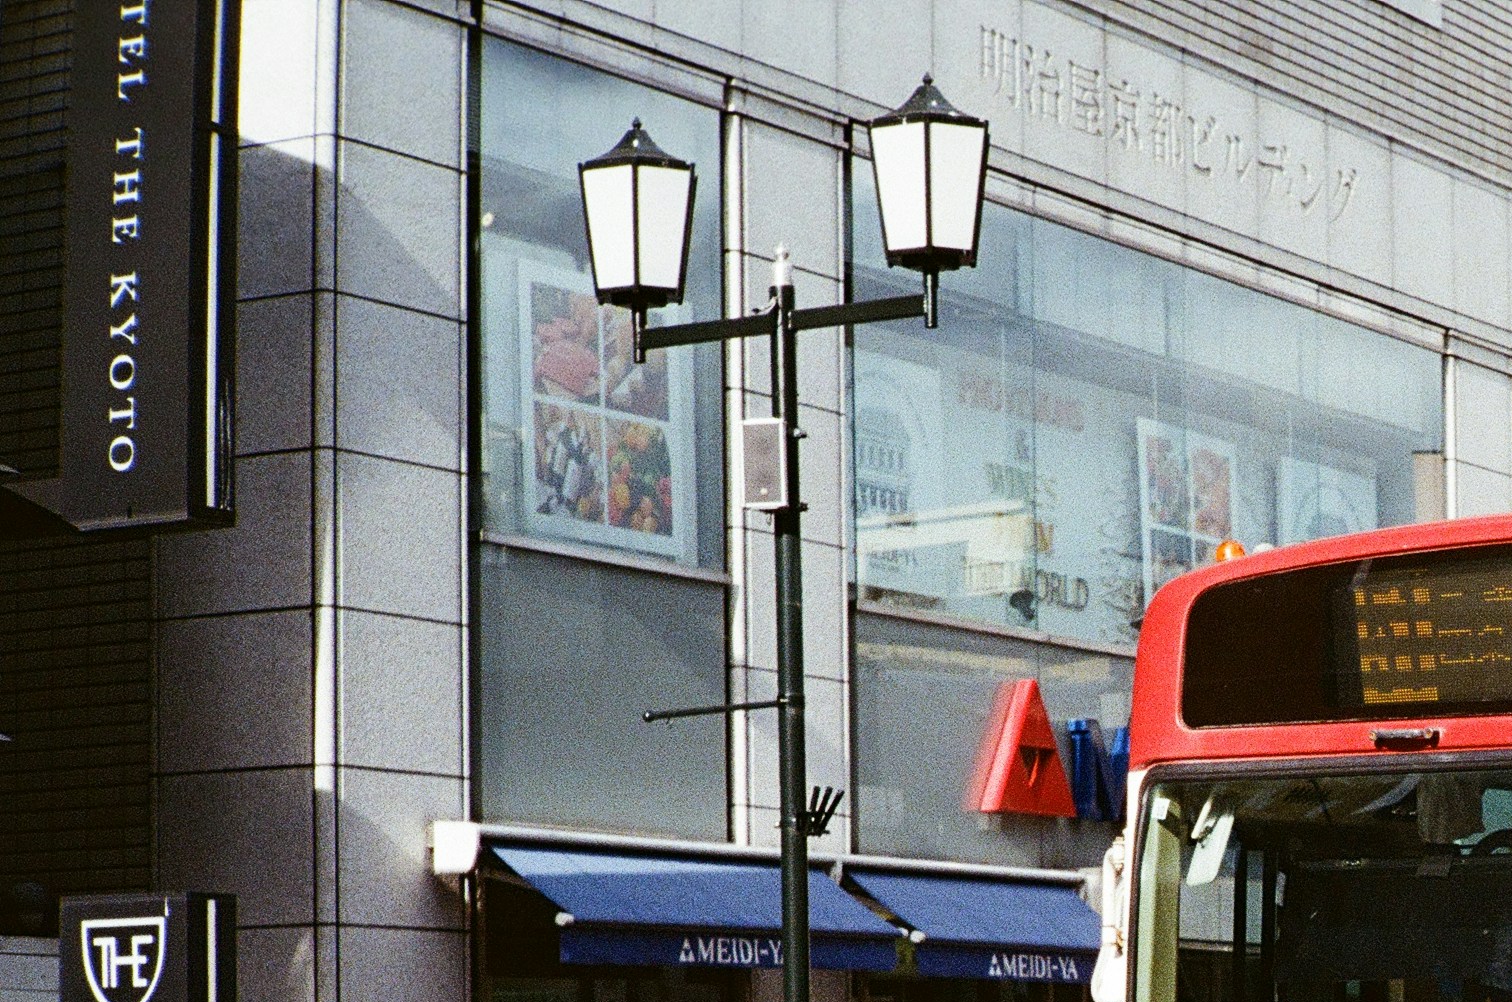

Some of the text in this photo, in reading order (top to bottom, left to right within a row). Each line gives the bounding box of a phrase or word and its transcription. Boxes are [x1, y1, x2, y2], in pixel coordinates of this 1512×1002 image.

[112, 127, 144, 244] THE
[108, 271, 139, 473] KYOTO
[92, 934, 154, 989] THE
[697, 937, 785, 965] MEIDI-Y
[1001, 953, 1079, 980] MEIDI-YA
